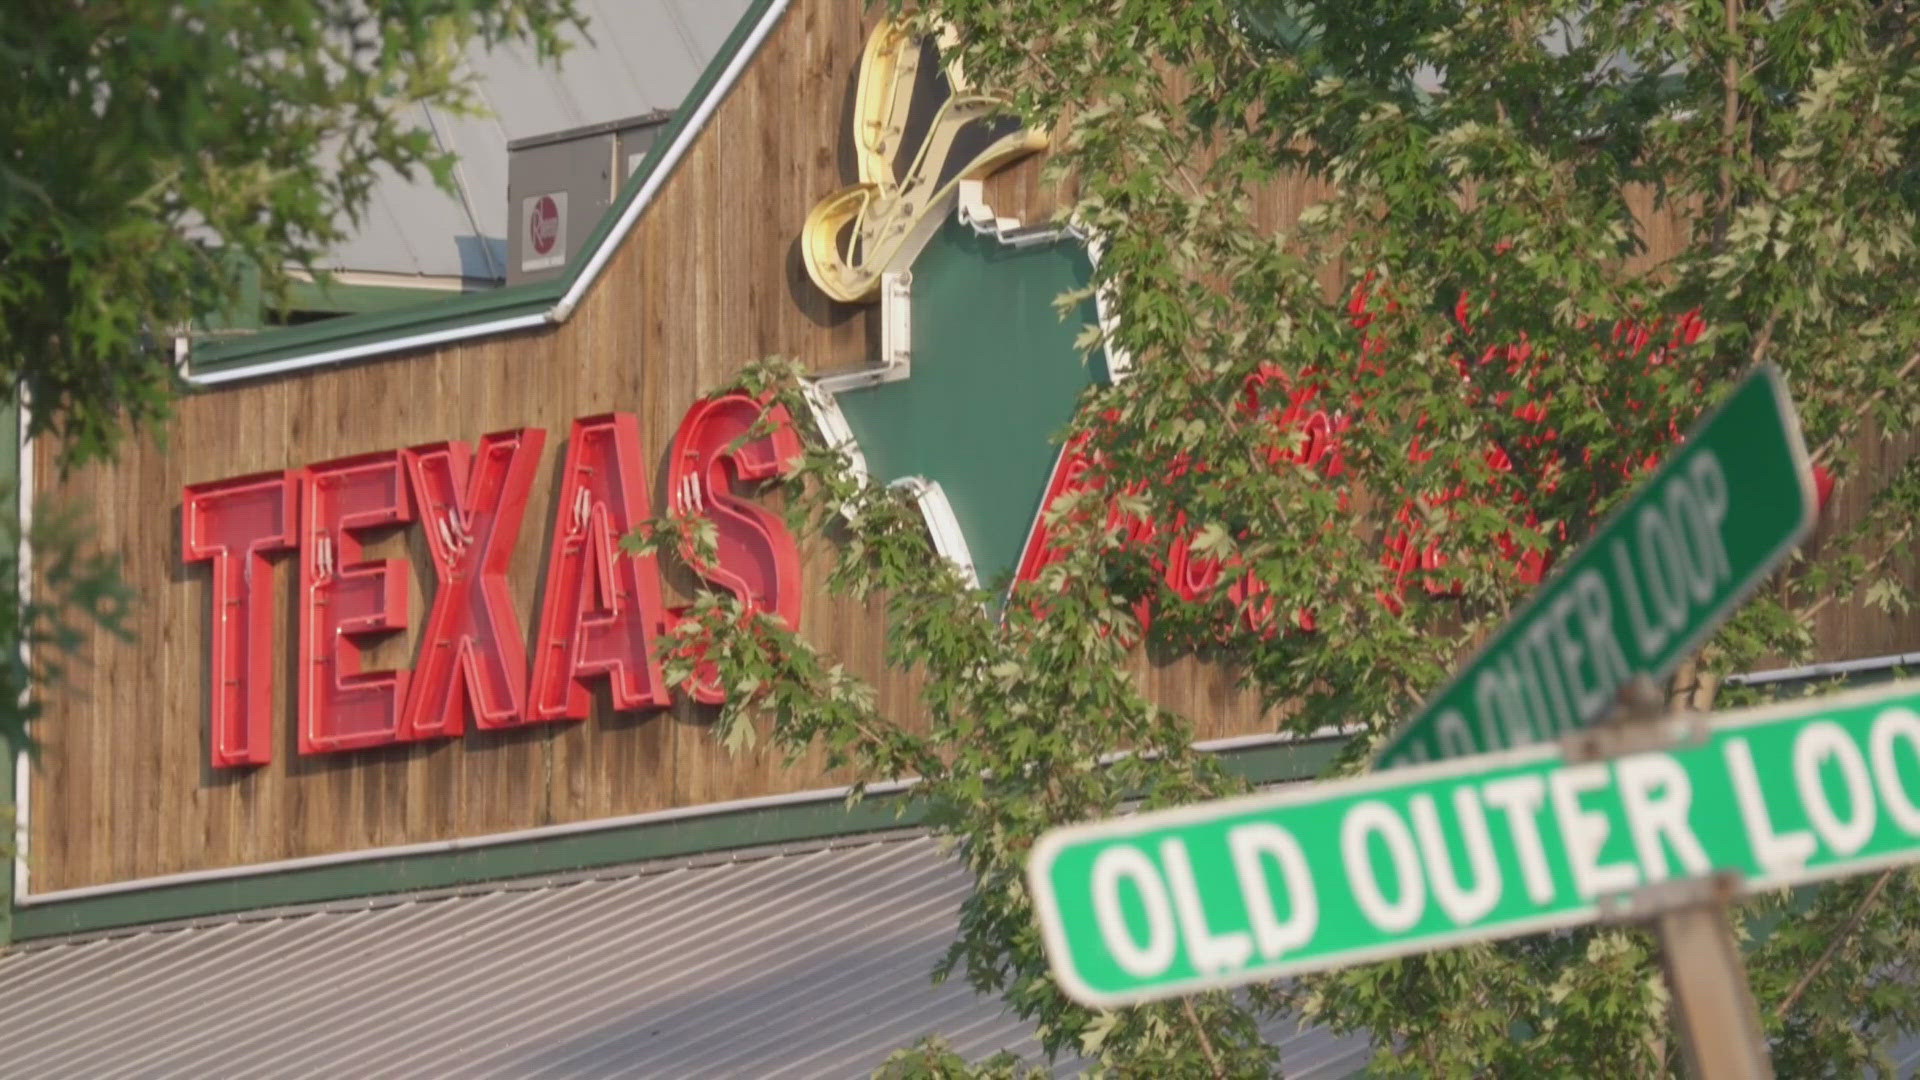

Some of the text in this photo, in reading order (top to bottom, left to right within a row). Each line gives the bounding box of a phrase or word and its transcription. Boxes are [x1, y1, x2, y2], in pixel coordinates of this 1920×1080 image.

[182, 390, 803, 768] TEXAS
[1608, 449, 1732, 656] LOOP
[1089, 821, 1321, 979] OLD
[1339, 750, 1713, 933] OUTER
